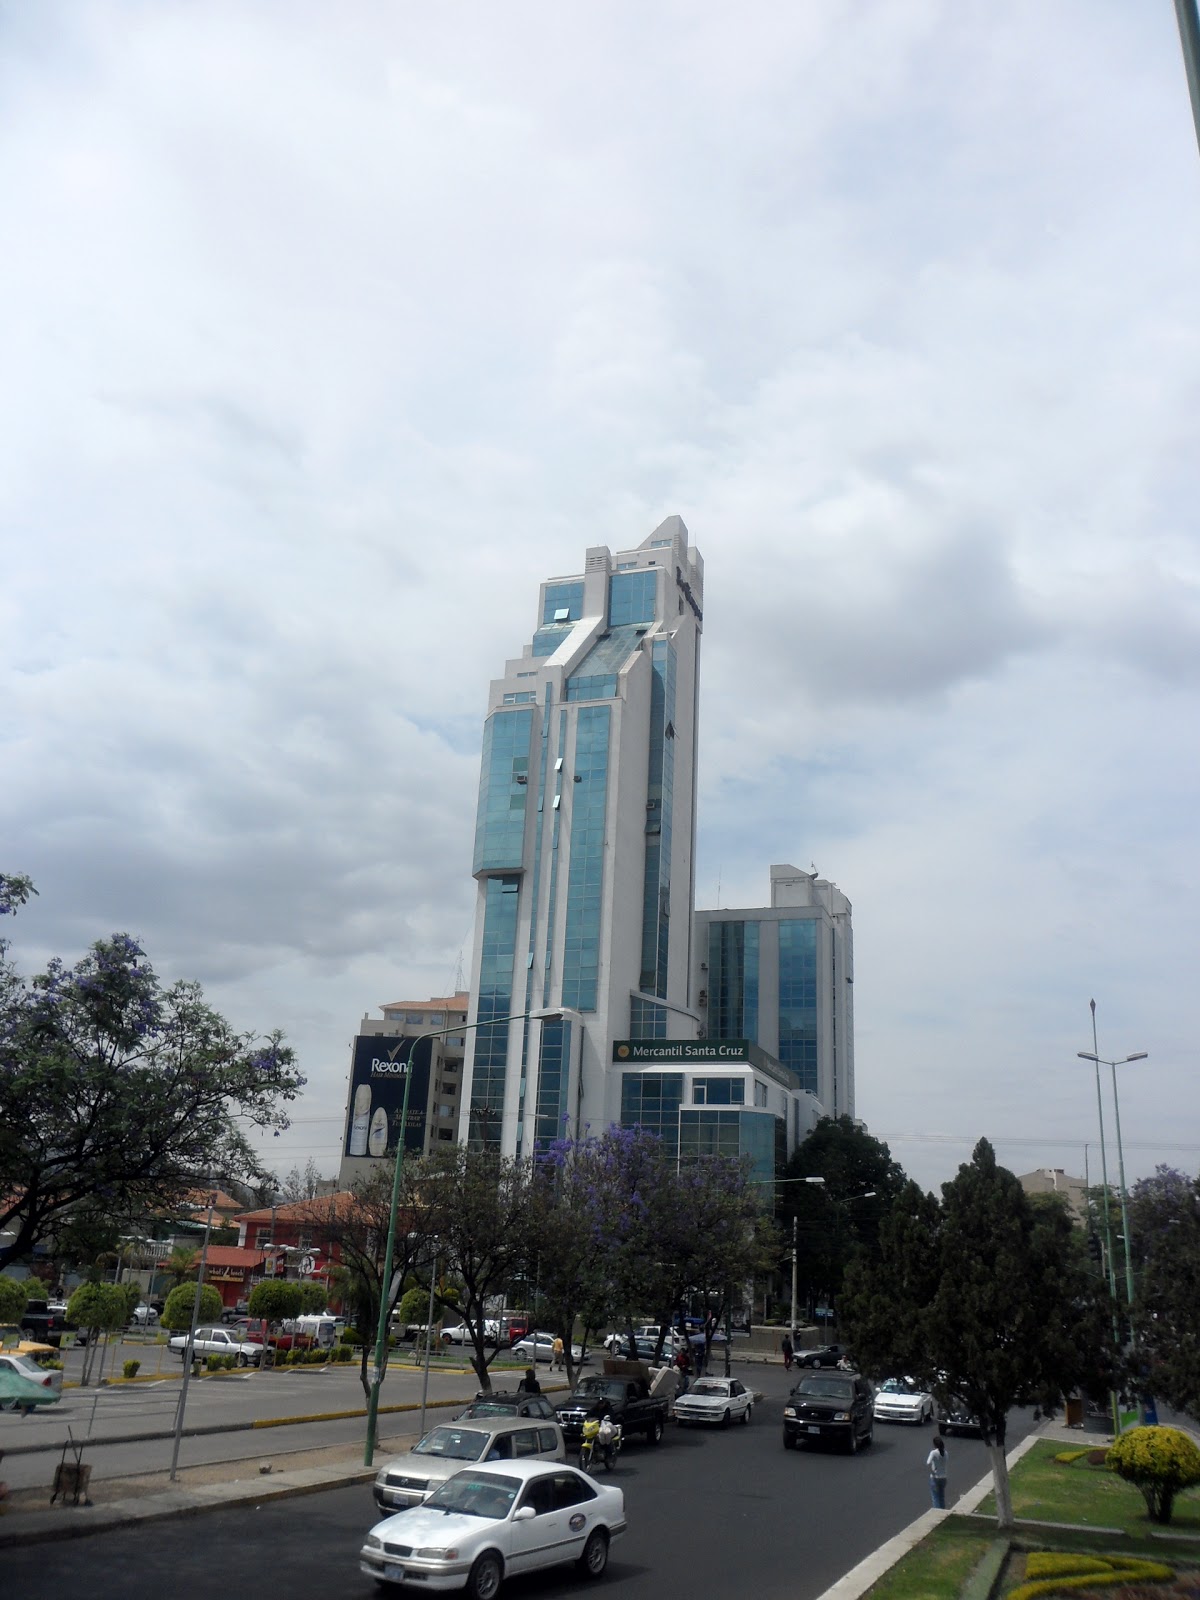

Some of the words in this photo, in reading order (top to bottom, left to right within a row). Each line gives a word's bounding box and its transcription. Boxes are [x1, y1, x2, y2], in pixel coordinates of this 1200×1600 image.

[633, 1045, 682, 1056] Mercantil
[685, 1045, 715, 1056] Santa
[718, 1045, 743, 1056] Cruz
